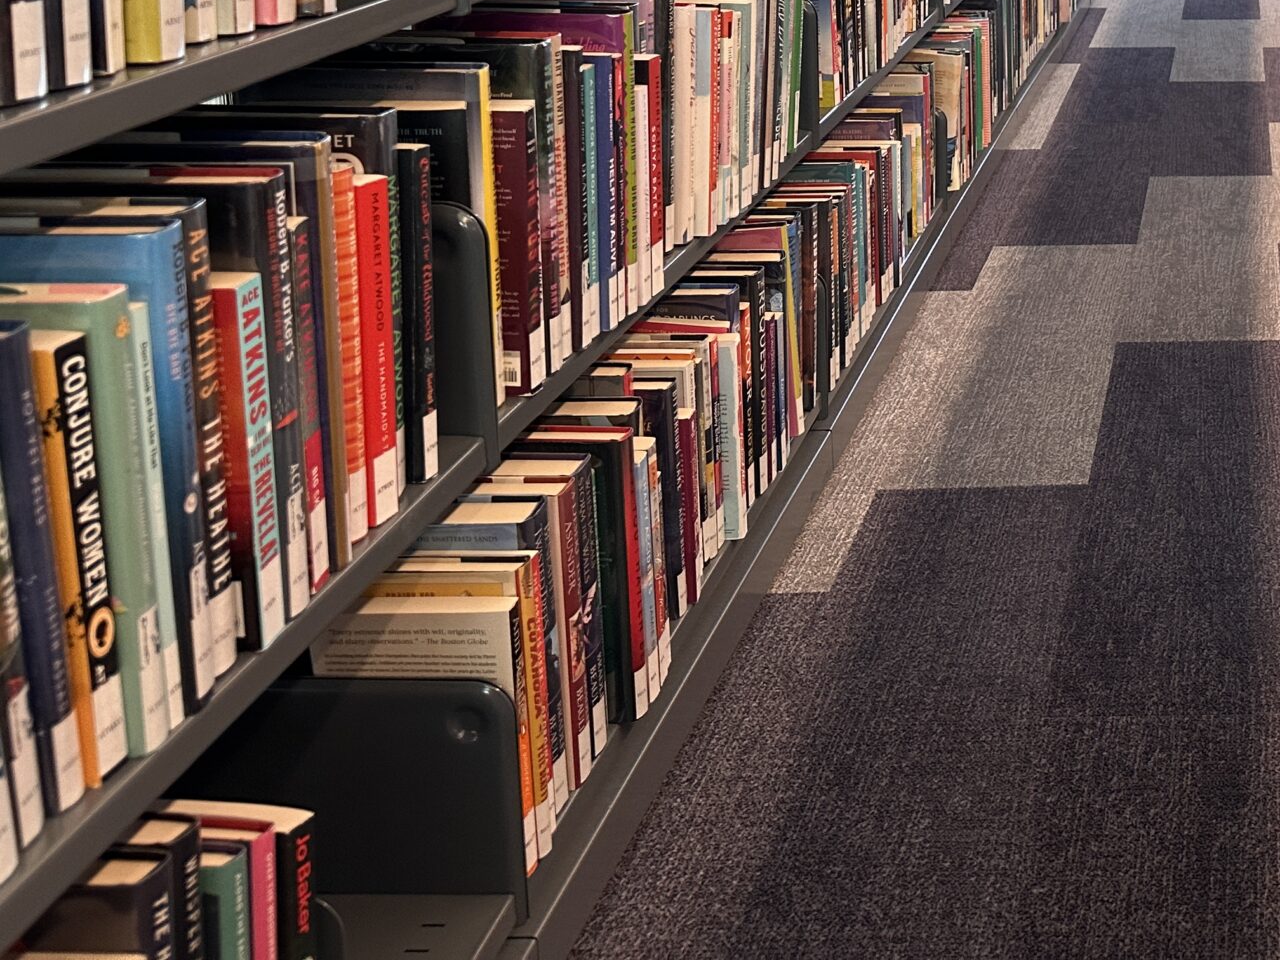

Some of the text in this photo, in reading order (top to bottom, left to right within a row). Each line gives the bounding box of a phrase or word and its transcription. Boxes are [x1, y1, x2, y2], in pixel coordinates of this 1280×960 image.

[242, 287, 260, 304] ACE
[274, 189, 296, 363] Robert Parker's
[295, 233, 317, 425] KATE ATKINSON
[370, 192, 390, 442] MARGARET ATWOOD HANDMAID'S
[189, 228, 232, 590] ACE ATKINS THE HEATHE
[240, 305, 268, 424] ATKINS
[61, 354, 108, 607] CONJURE WOMEN
[564, 521, 578, 595] ASUNDER
[526, 617, 543, 722] CUYAHOGA
[152, 891, 170, 941] THE
[295, 834, 312, 934] Jo Baker
